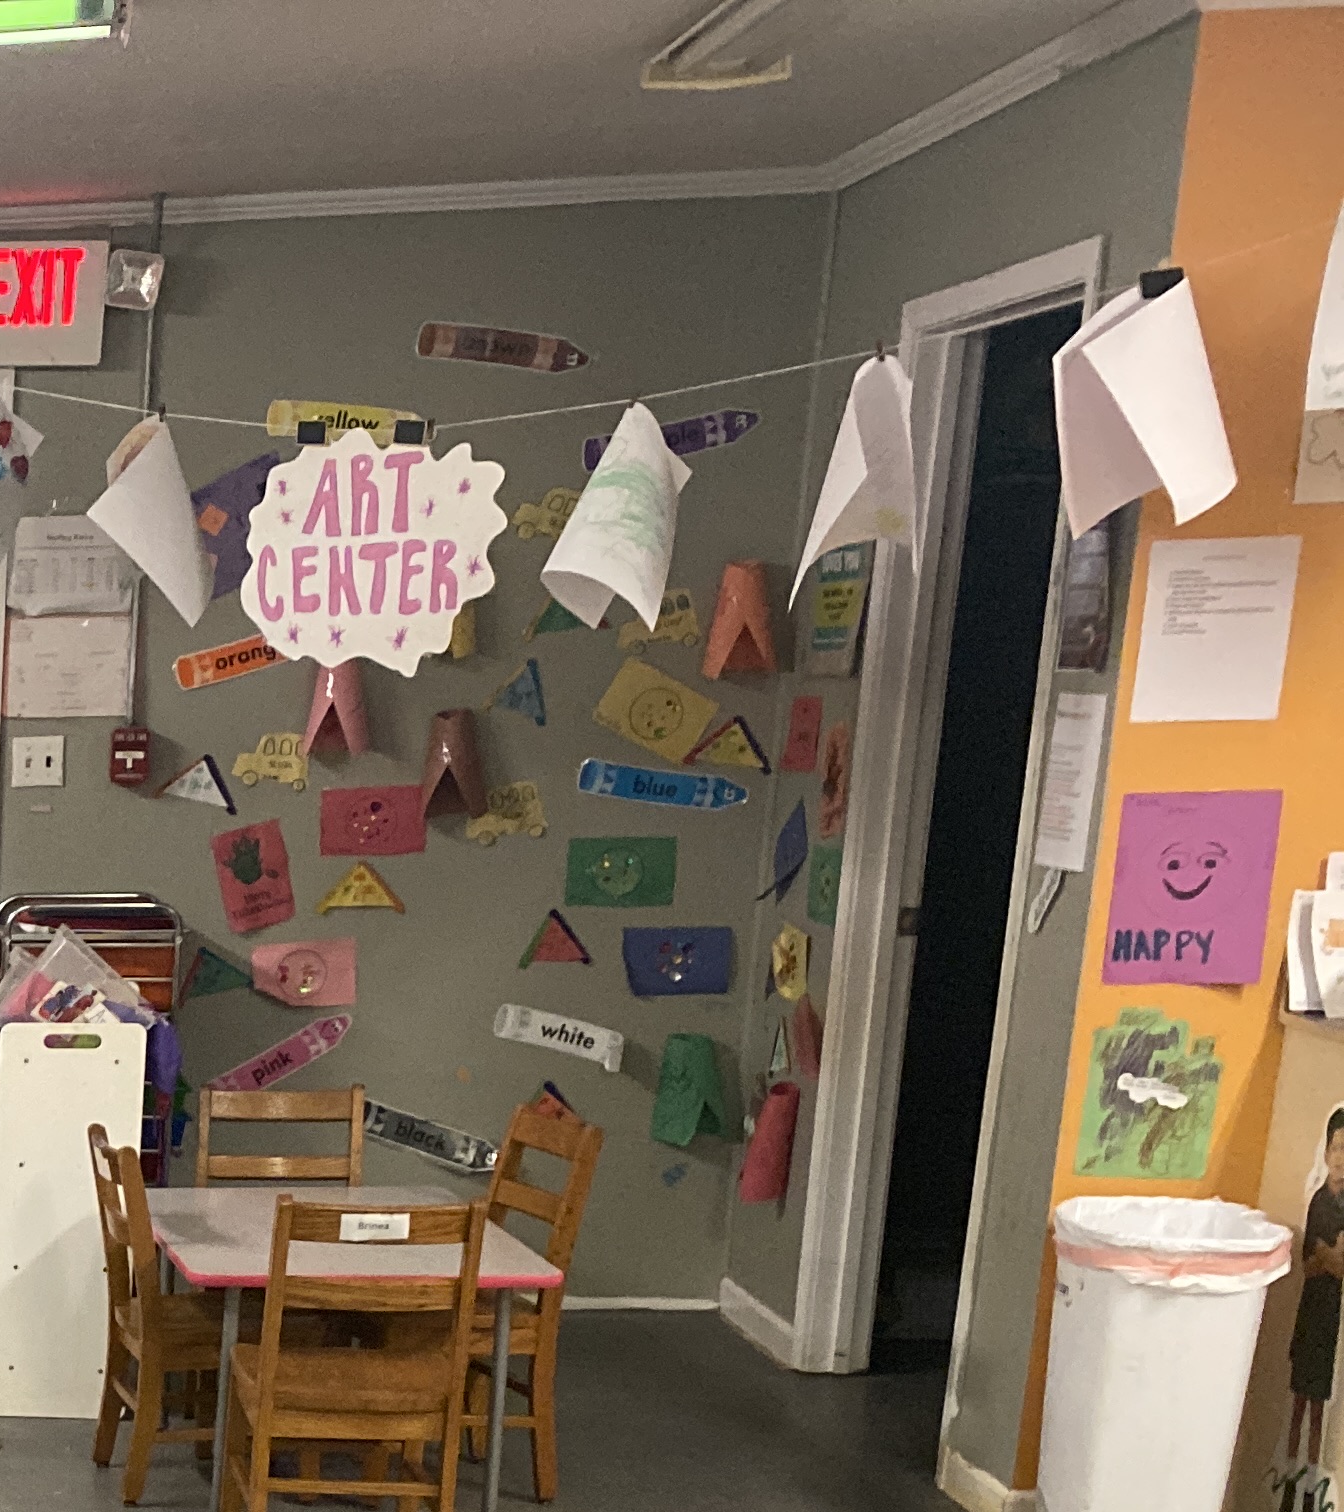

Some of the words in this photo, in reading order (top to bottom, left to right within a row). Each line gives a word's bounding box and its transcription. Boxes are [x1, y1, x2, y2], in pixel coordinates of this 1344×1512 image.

[301, 450, 425, 537] ART
[256, 538, 459, 622] CENTER
[214, 644, 277, 671] orang
[632, 774, 679, 798] blue
[1111, 928, 1215, 965] HAPPY
[540, 1023, 596, 1050] white
[251, 1050, 294, 1086] pink
[394, 1120, 447, 1150] black
